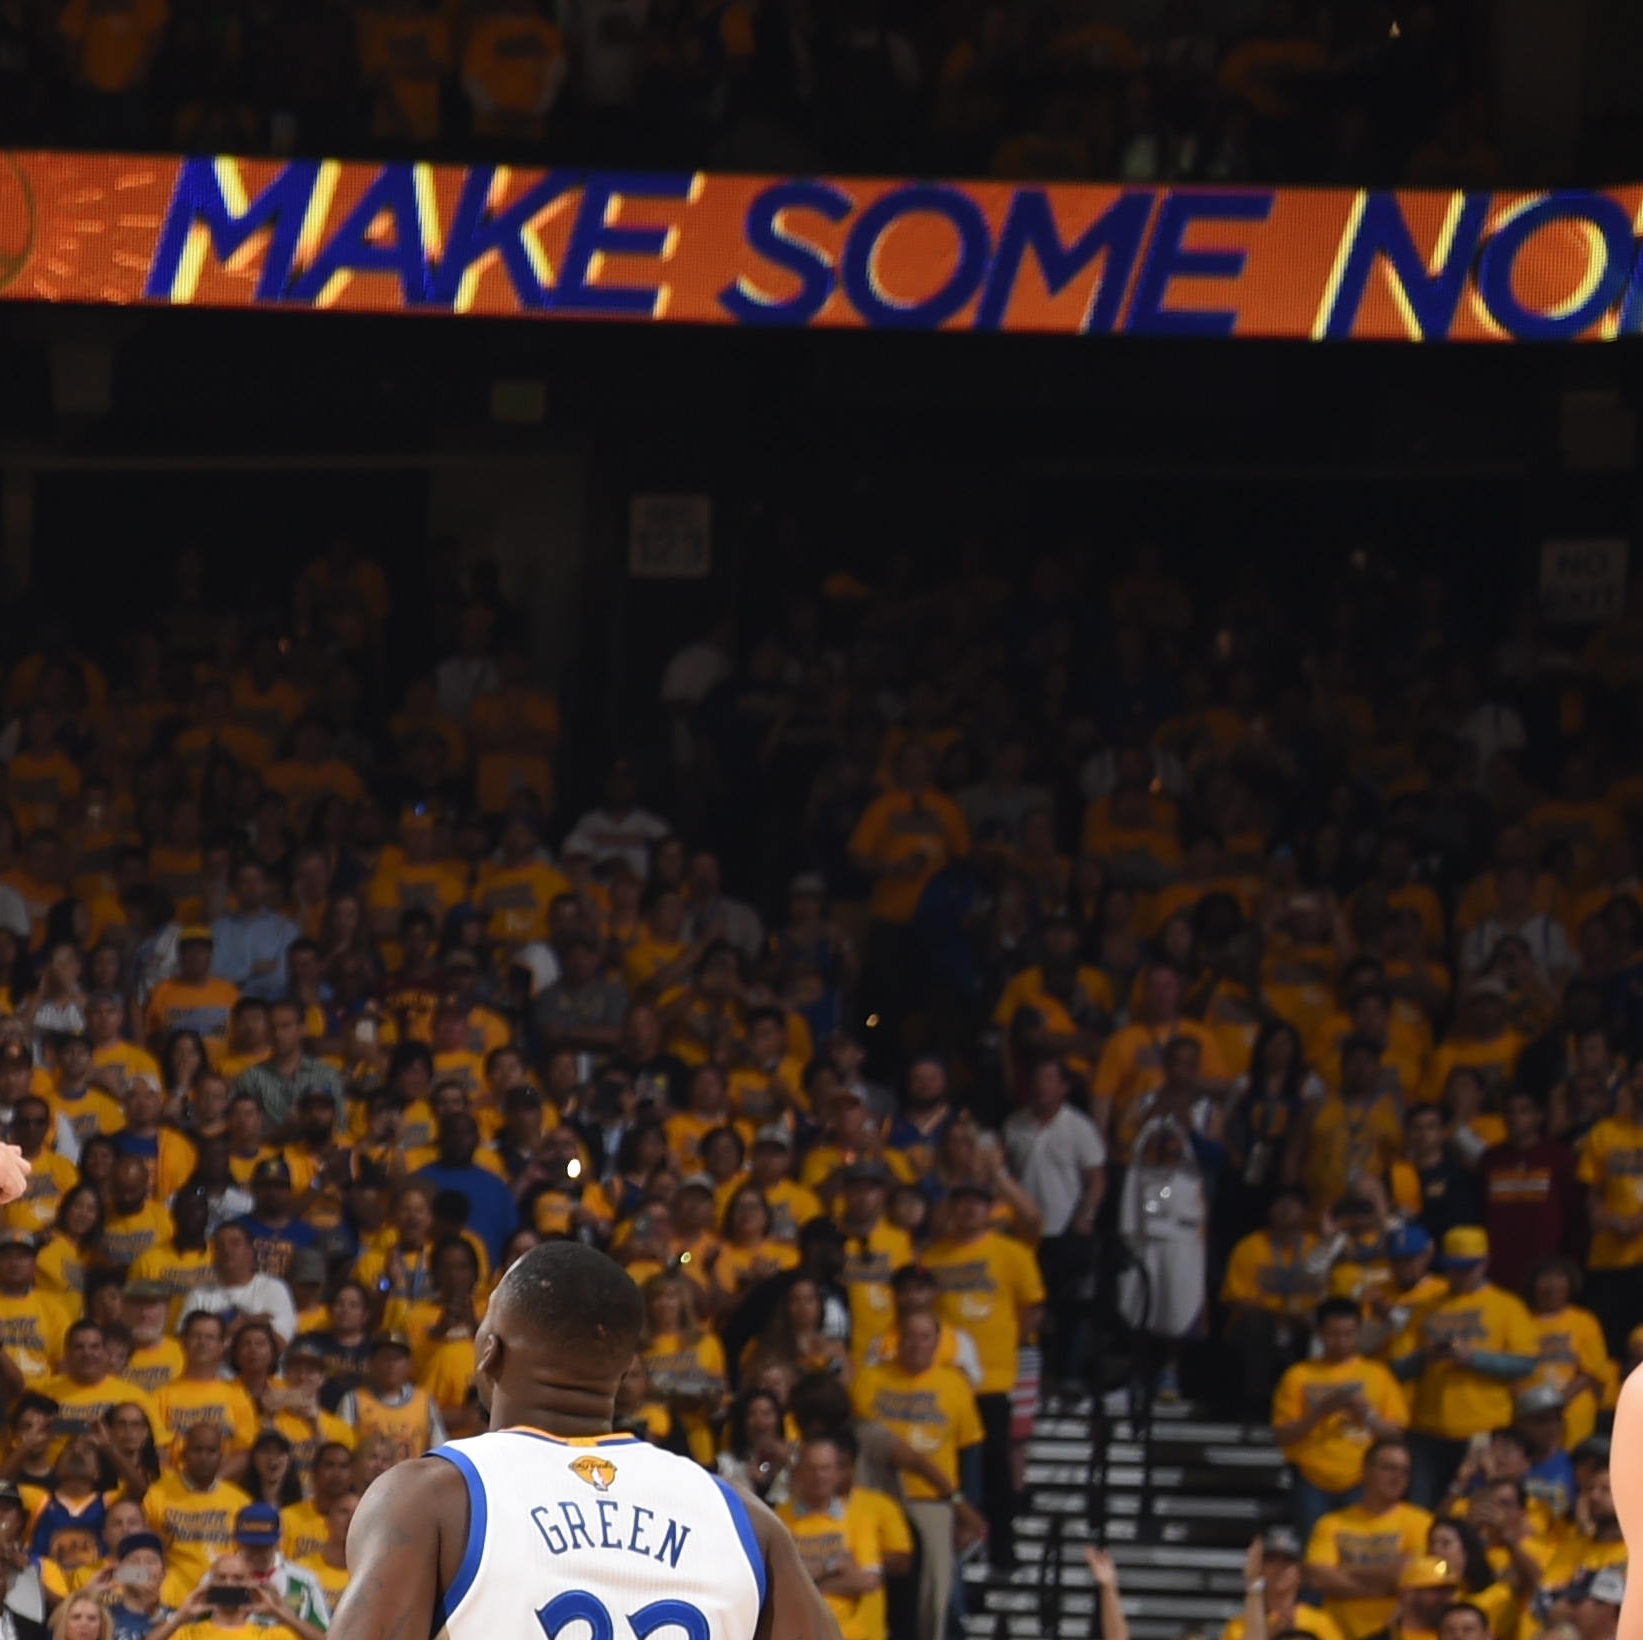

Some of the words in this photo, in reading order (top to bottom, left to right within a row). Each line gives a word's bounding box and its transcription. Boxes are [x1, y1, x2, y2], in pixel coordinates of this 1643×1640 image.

[142, 154, 705, 319] MAKE
[718, 180, 1276, 338] SOME
[530, 1499, 691, 1569] GREEN
